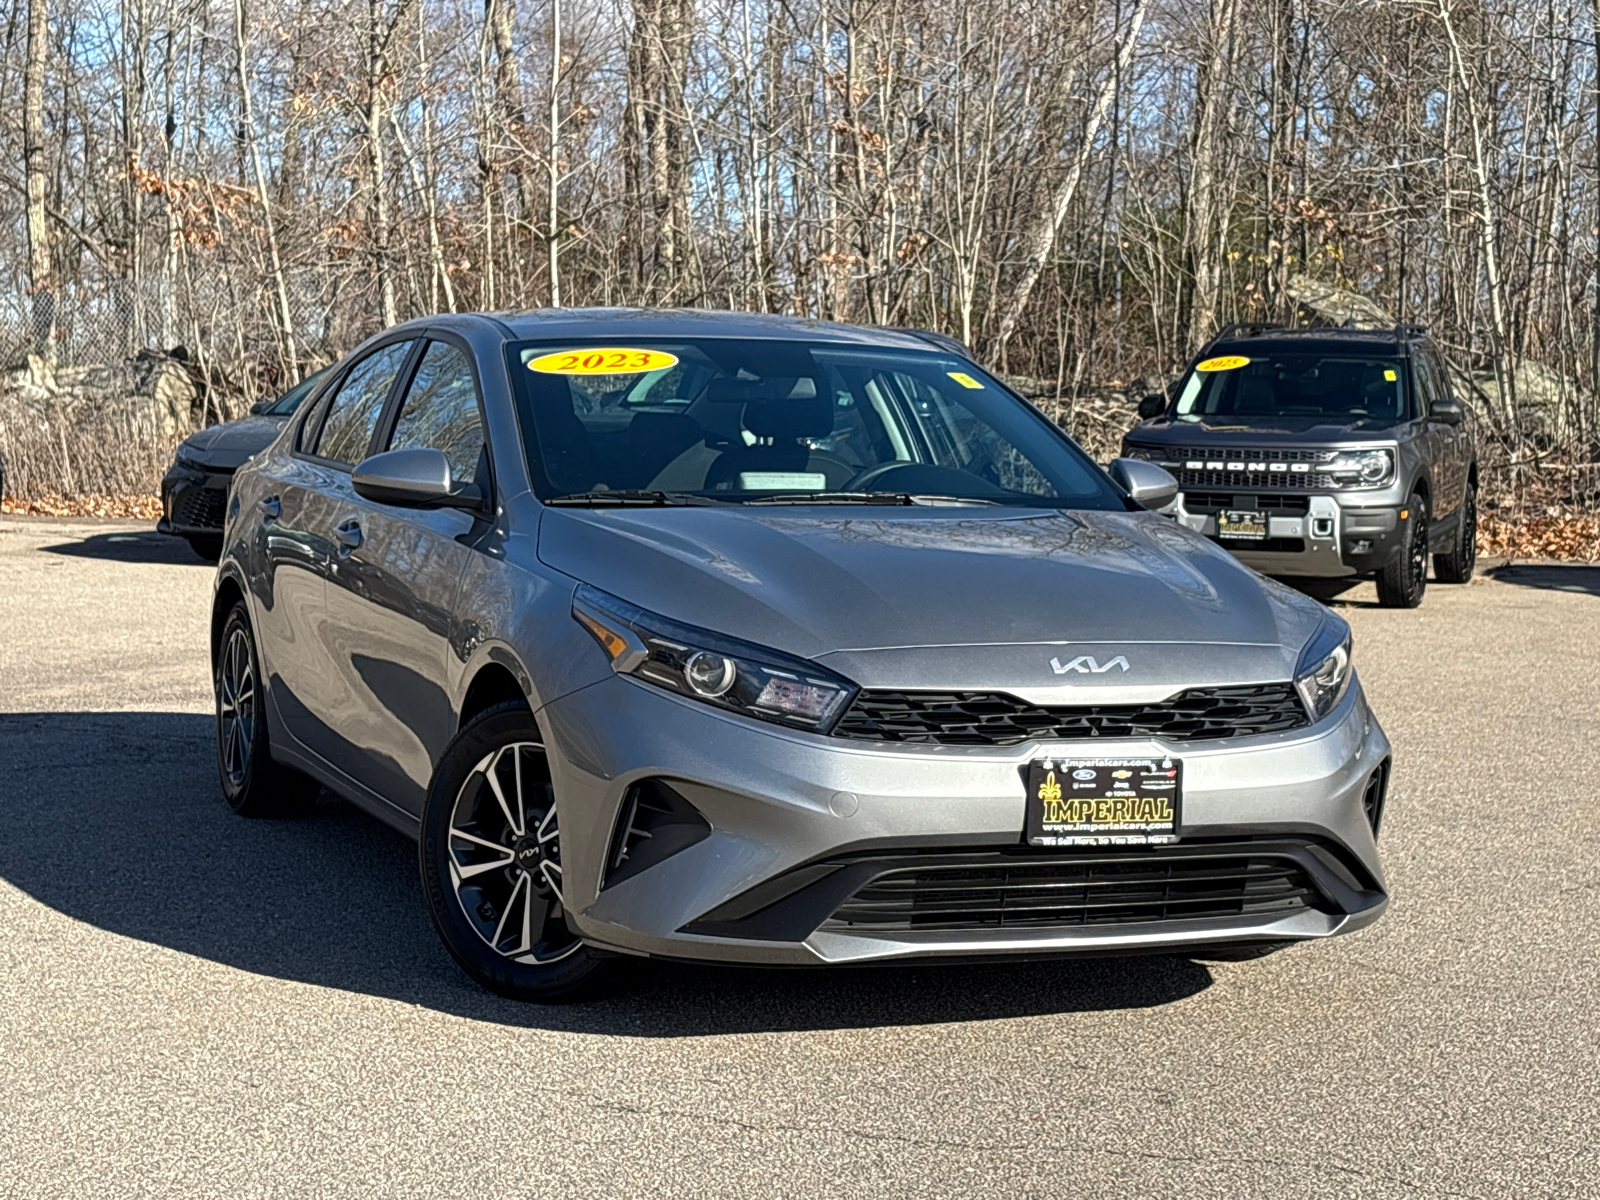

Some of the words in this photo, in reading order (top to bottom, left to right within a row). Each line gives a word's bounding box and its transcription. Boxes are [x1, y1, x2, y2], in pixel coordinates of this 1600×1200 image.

[557, 353, 652, 370] 2023
[1203, 358, 1241, 369] 2025
[1185, 461, 1309, 472] BRONCO
[1049, 655, 1130, 674] KIA
[1064, 759, 1152, 768] Imperialcars.com
[1043, 798, 1173, 823] IMPERIAL
[1042, 822, 1173, 832] www.imperialcars.com
[1043, 837, 1056, 845] We
[1058, 837, 1072, 845] Sell
[1098, 837, 1109, 845] So
[1110, 836, 1126, 844] You
[1127, 836, 1146, 844] Save
[1148, 835, 1168, 843] More
[425, 837, 447, 916] KUMHO
